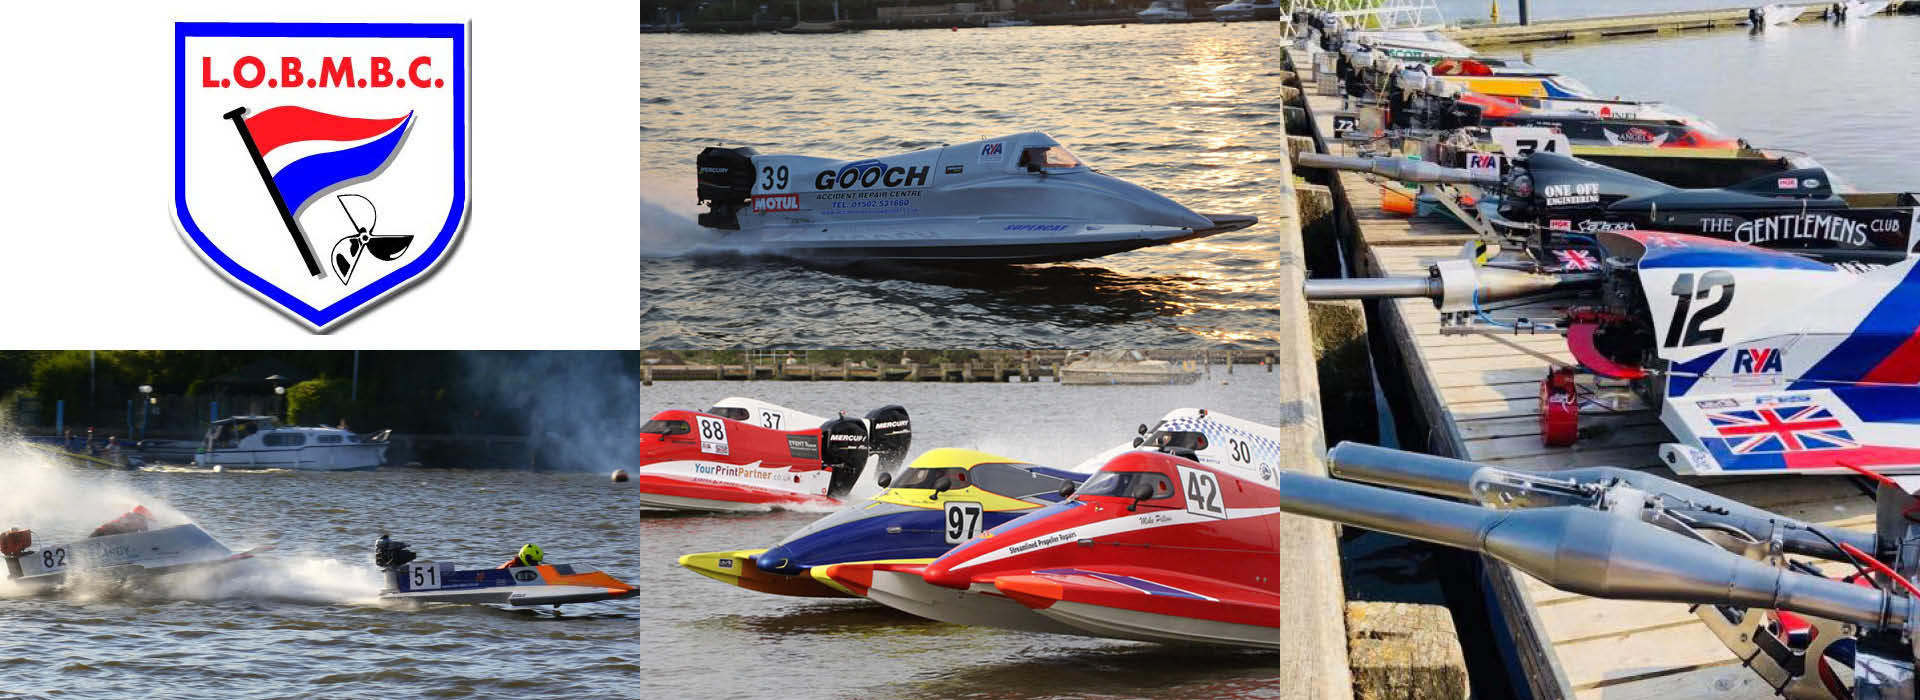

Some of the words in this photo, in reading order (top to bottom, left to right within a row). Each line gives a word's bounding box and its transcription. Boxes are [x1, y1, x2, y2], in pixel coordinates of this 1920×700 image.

[202, 56, 444, 89] L.O.B.M.B.C.
[981, 144, 1003, 155] RYA
[1471, 155, 1496, 168] RYA
[762, 165, 789, 190] 39
[815, 165, 930, 190] GOOCH
[816, 192, 856, 200] ACCIDENT
[1545, 185, 1572, 197] ONE
[1576, 183, 1599, 194] OFF
[754, 197, 798, 210] MOTUL
[1701, 218, 1733, 232] THE
[1735, 213, 1868, 246] GENTLEMENS
[1870, 218, 1900, 232] CLUB
[1663, 270, 1736, 348] 12
[1732, 348, 1783, 374] RYA
[701, 420, 724, 441] 88
[762, 412, 782, 430] 37
[875, 421, 909, 430] MERCURY
[1229, 438, 1251, 464] 30
[1187, 471, 1222, 514] 42
[949, 506, 980, 540] 97
[1009, 541, 1038, 554] Streamlined
[1037, 536, 1060, 548] Propeller
[1058, 531, 1077, 543] Repairs
[43, 548, 66, 568] 82
[414, 566, 436, 586] 51
